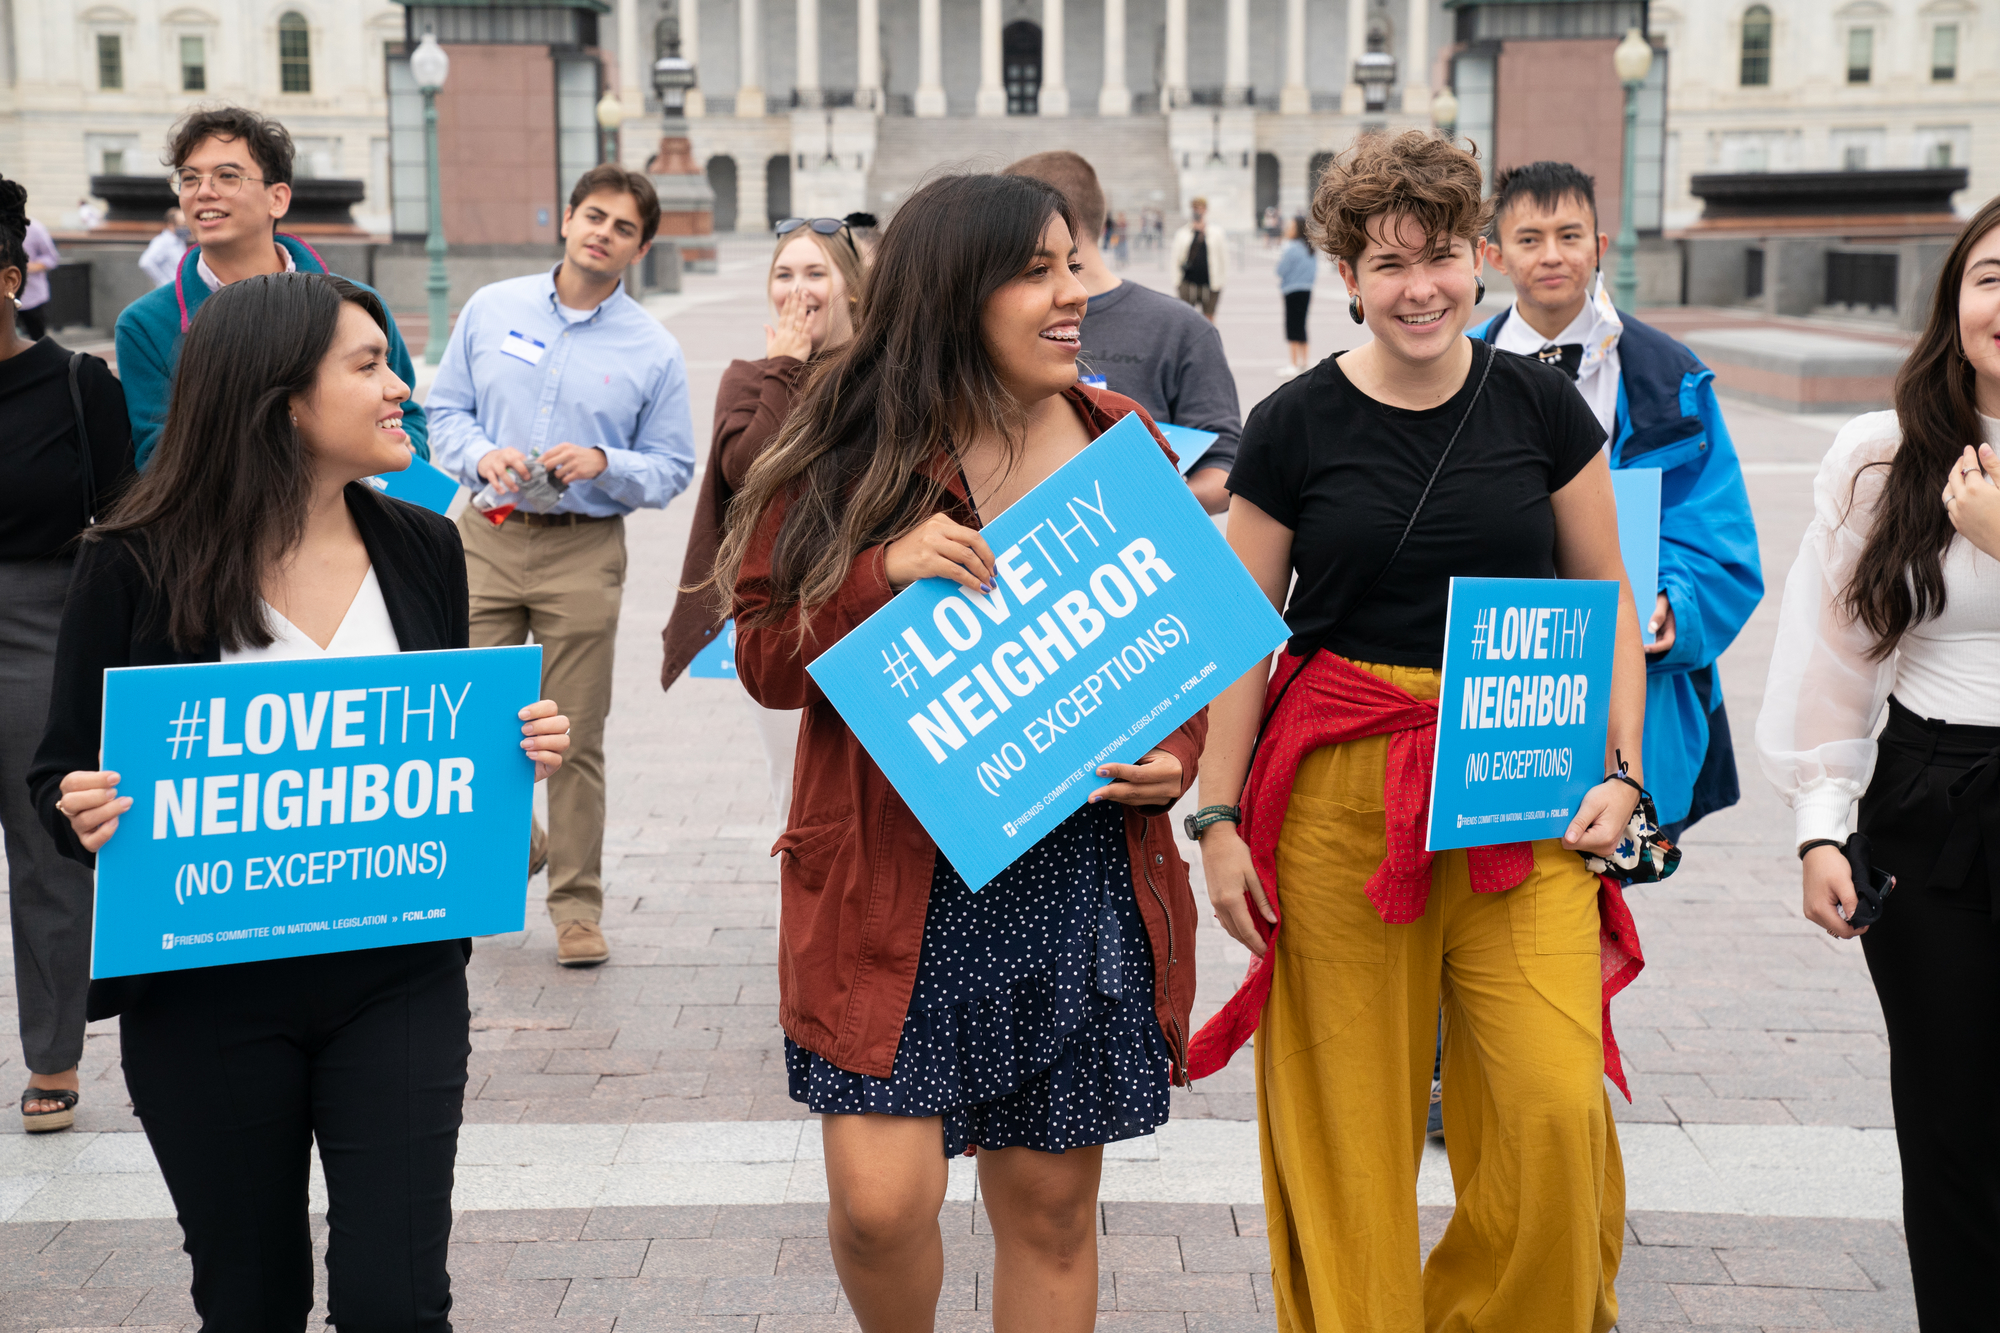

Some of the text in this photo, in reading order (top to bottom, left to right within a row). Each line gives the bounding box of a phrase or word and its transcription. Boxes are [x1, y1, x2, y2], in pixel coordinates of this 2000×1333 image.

[882, 480, 1117, 698] #LOVETHY
[907, 537, 1177, 765] NEIGHBOR
[1471, 606, 1592, 661] #LOVETHY
[166, 681, 472, 760] #LOVETHY
[976, 613, 1190, 797] (NO EXCEPTIONS)
[1460, 673, 1589, 730] NEIGHBOR
[1013, 801, 1045, 830] FRIENDS
[1043, 768, 1085, 806] COMMITTEE
[1083, 759, 1097, 773] ON
[1094, 733, 1131, 764] NATIONAL
[1128, 697, 1173, 737] LEGISLATION
[1180, 661, 1218, 694] FCNL.ORG
[1465, 747, 1573, 790] (NO EXCEPTIONS)
[152, 756, 475, 840] NEIGHBOR
[1462, 816, 1478, 826] FRIENDS
[1478, 814, 1499, 824] COMMITTEE
[1505, 812, 1523, 822] NATIONAL
[1523, 810, 1546, 820] LEGISLATION
[1550, 808, 1569, 818] FCNL.ORG
[175, 840, 447, 905] (NO EXCEPTIONS)
[174, 932, 214, 946] FRIENDS
[216, 926, 270, 942] COMMITTEE
[272, 925, 286, 936] ON
[287, 920, 331, 934] NATIONAL
[332, 914, 388, 930] LEGISLATION
[402, 908, 446, 922] FCNL.ORG
